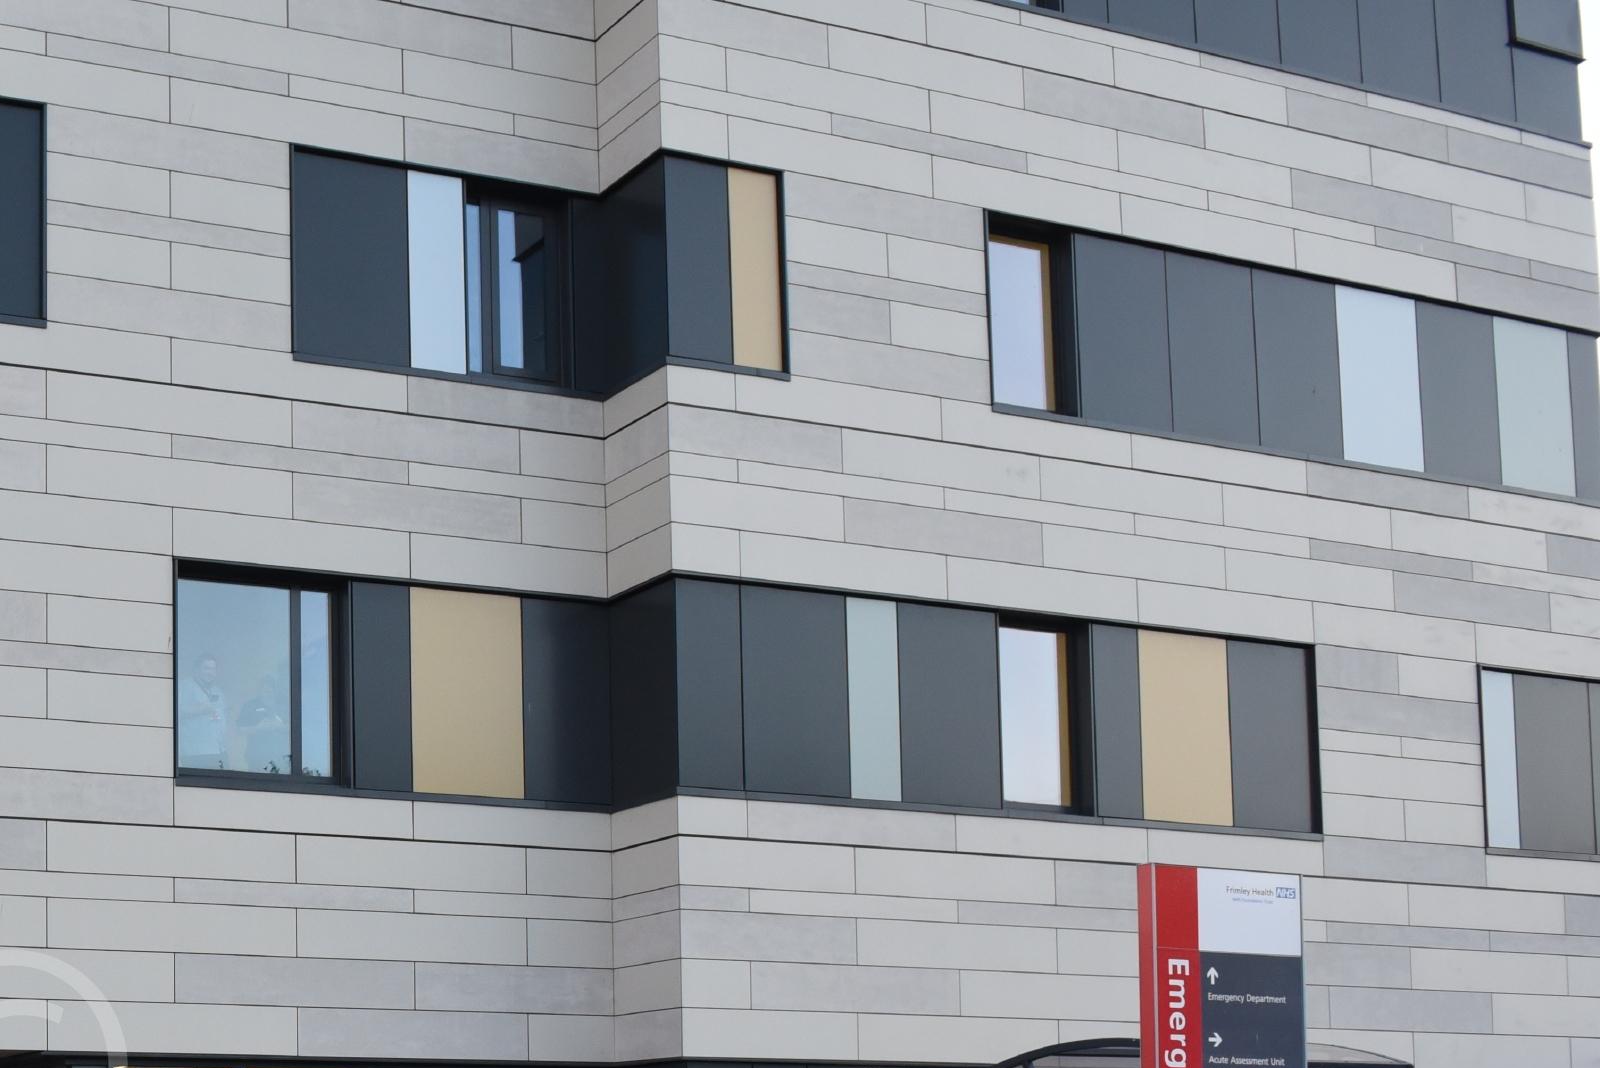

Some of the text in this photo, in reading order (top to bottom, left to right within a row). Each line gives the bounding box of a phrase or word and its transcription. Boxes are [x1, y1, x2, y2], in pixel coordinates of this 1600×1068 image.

[1226, 885, 1296, 899] Frimley Health NHS
[1207, 992, 1286, 1004] Emergency Department
[1208, 1056, 1285, 1066] Acute Assessment Unit
